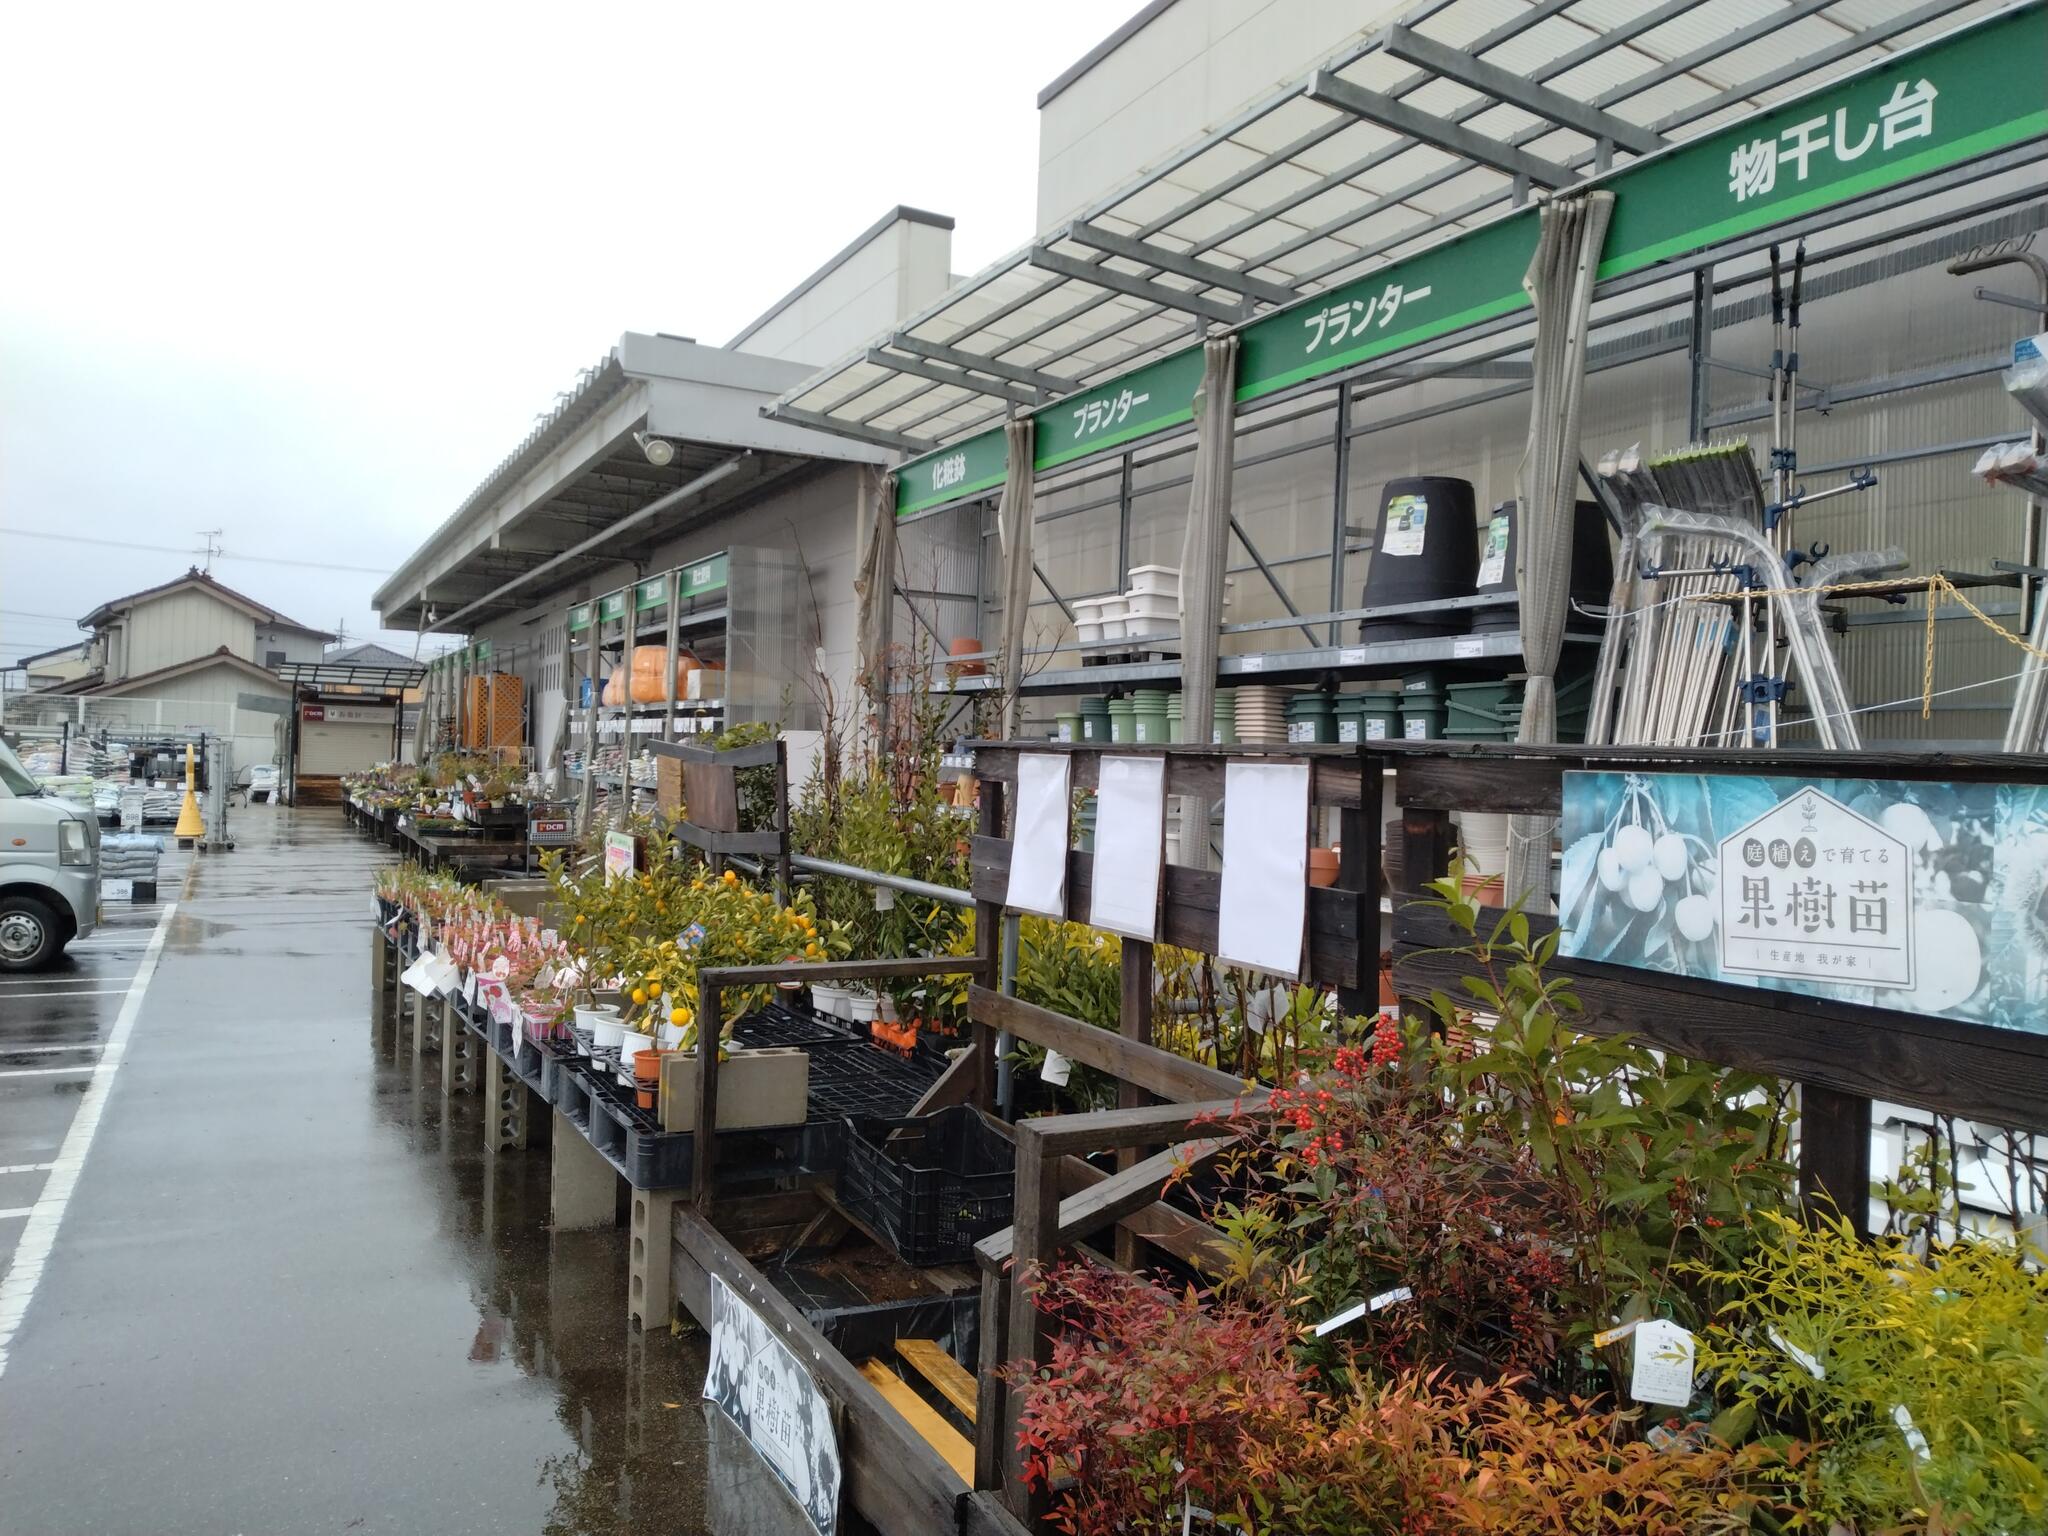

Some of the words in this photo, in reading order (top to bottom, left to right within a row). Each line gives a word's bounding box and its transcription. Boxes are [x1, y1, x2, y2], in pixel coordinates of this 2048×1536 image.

[1729, 78, 1938, 202] 物干し台
[1304, 284, 1432, 354] プランター
[1074, 389, 1149, 439] プランター
[1743, 839, 1889, 867] 庭植えで育てる
[1737, 875, 1889, 935] 果樹苗
[1769, 949, 1806, 963] 生産地
[1816, 952, 1858, 967] 我が家
